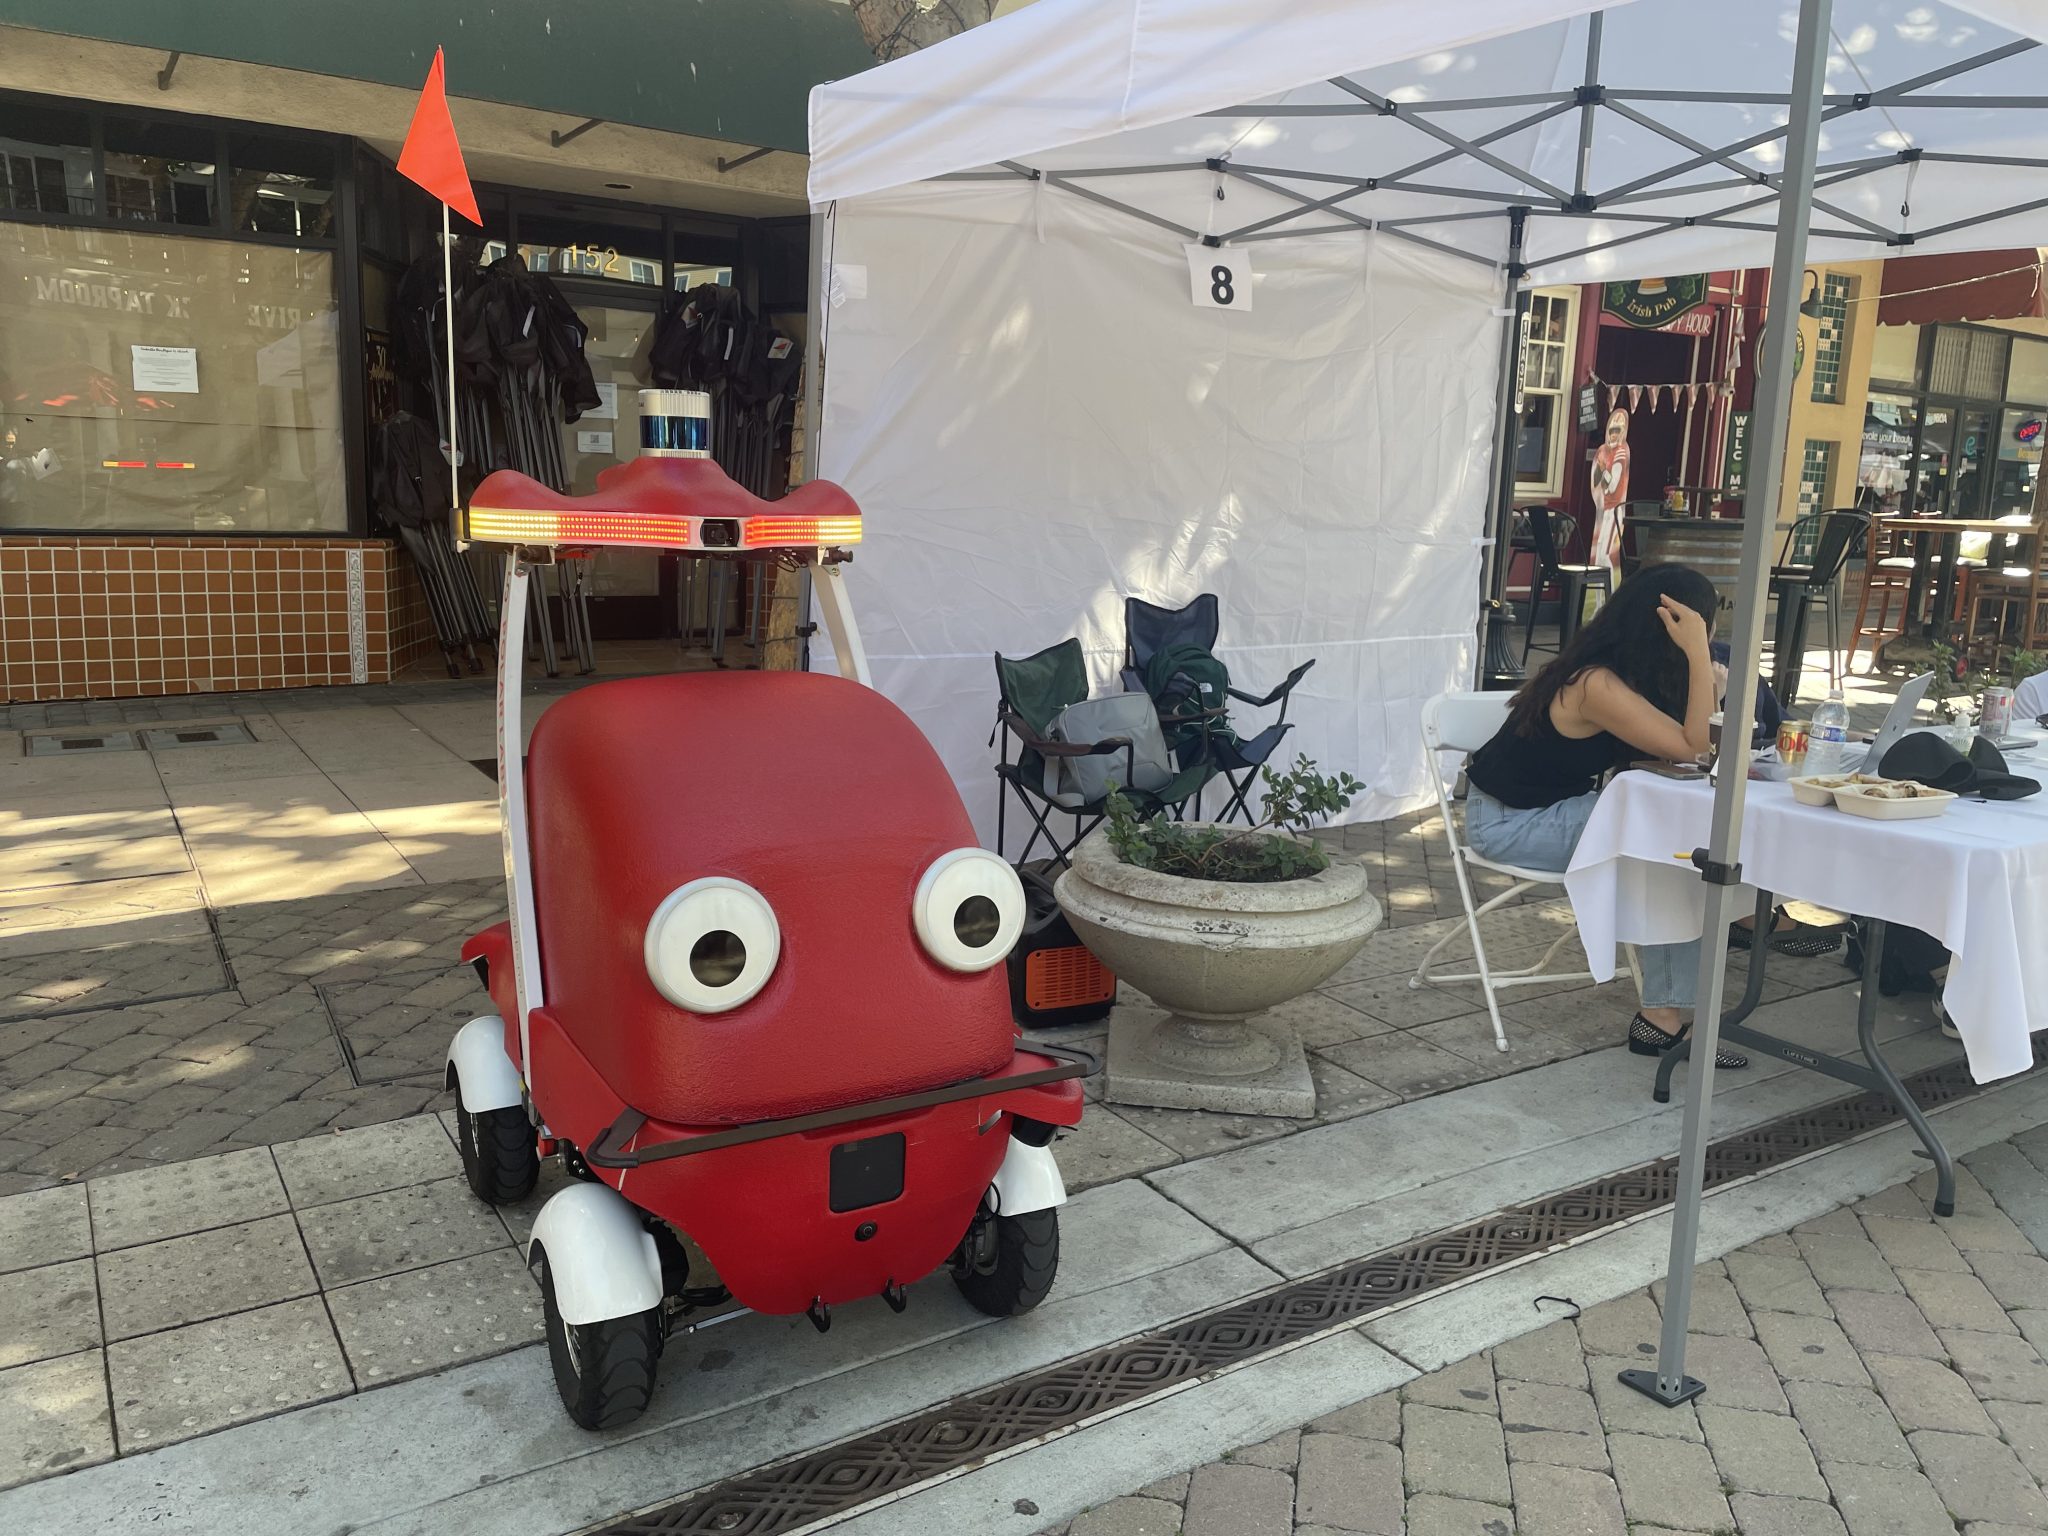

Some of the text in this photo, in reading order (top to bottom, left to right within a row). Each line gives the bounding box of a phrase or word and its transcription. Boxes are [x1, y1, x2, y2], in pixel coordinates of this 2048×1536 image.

[568, 244, 619, 273] 152
[1211, 265, 1234, 305] 8
[1627, 297, 1677, 317] Irish Pub
[1686, 312, 1711, 335] HOUR
[1729, 415, 1748, 497] WELCME
[1778, 731, 1809, 752] ok
